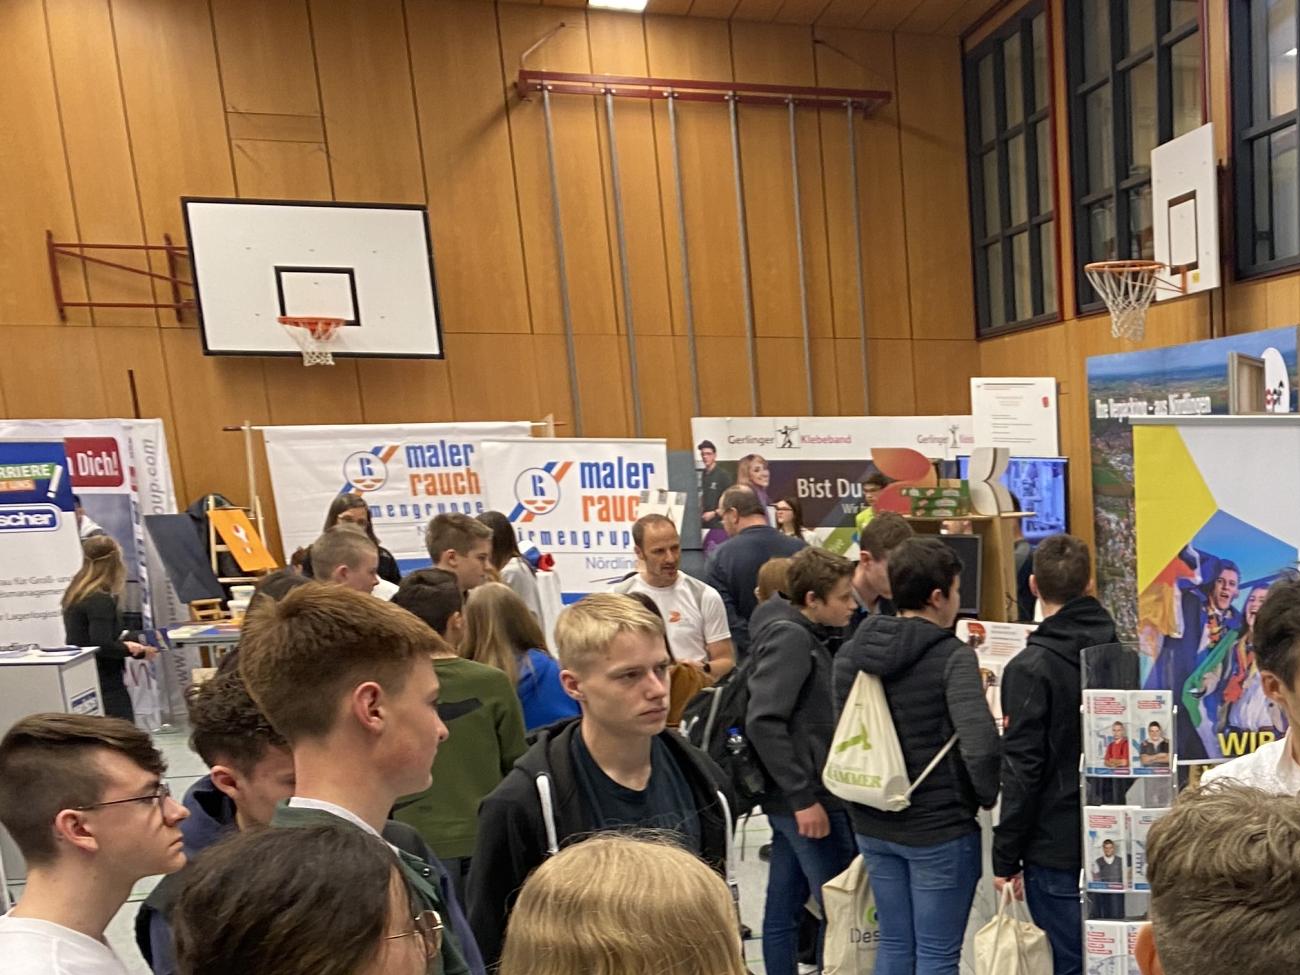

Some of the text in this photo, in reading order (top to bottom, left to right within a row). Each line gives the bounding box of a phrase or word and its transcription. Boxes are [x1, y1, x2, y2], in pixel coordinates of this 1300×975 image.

[77, 450, 119, 476] Dich!
[405, 440, 474, 468] maler
[0, 463, 51, 479] RRIERE
[579, 456, 655, 489] maler
[409, 467, 481, 496] rauch
[796, 478, 863, 498] Bist Du
[0, 511, 52, 526] scher
[370, 501, 485, 519] mengruppe
[581, 495, 640, 522] rauc
[517, 528, 631, 549] irmengrup
[585, 557, 638, 570] Nördlin
[850, 927, 881, 944] Des
